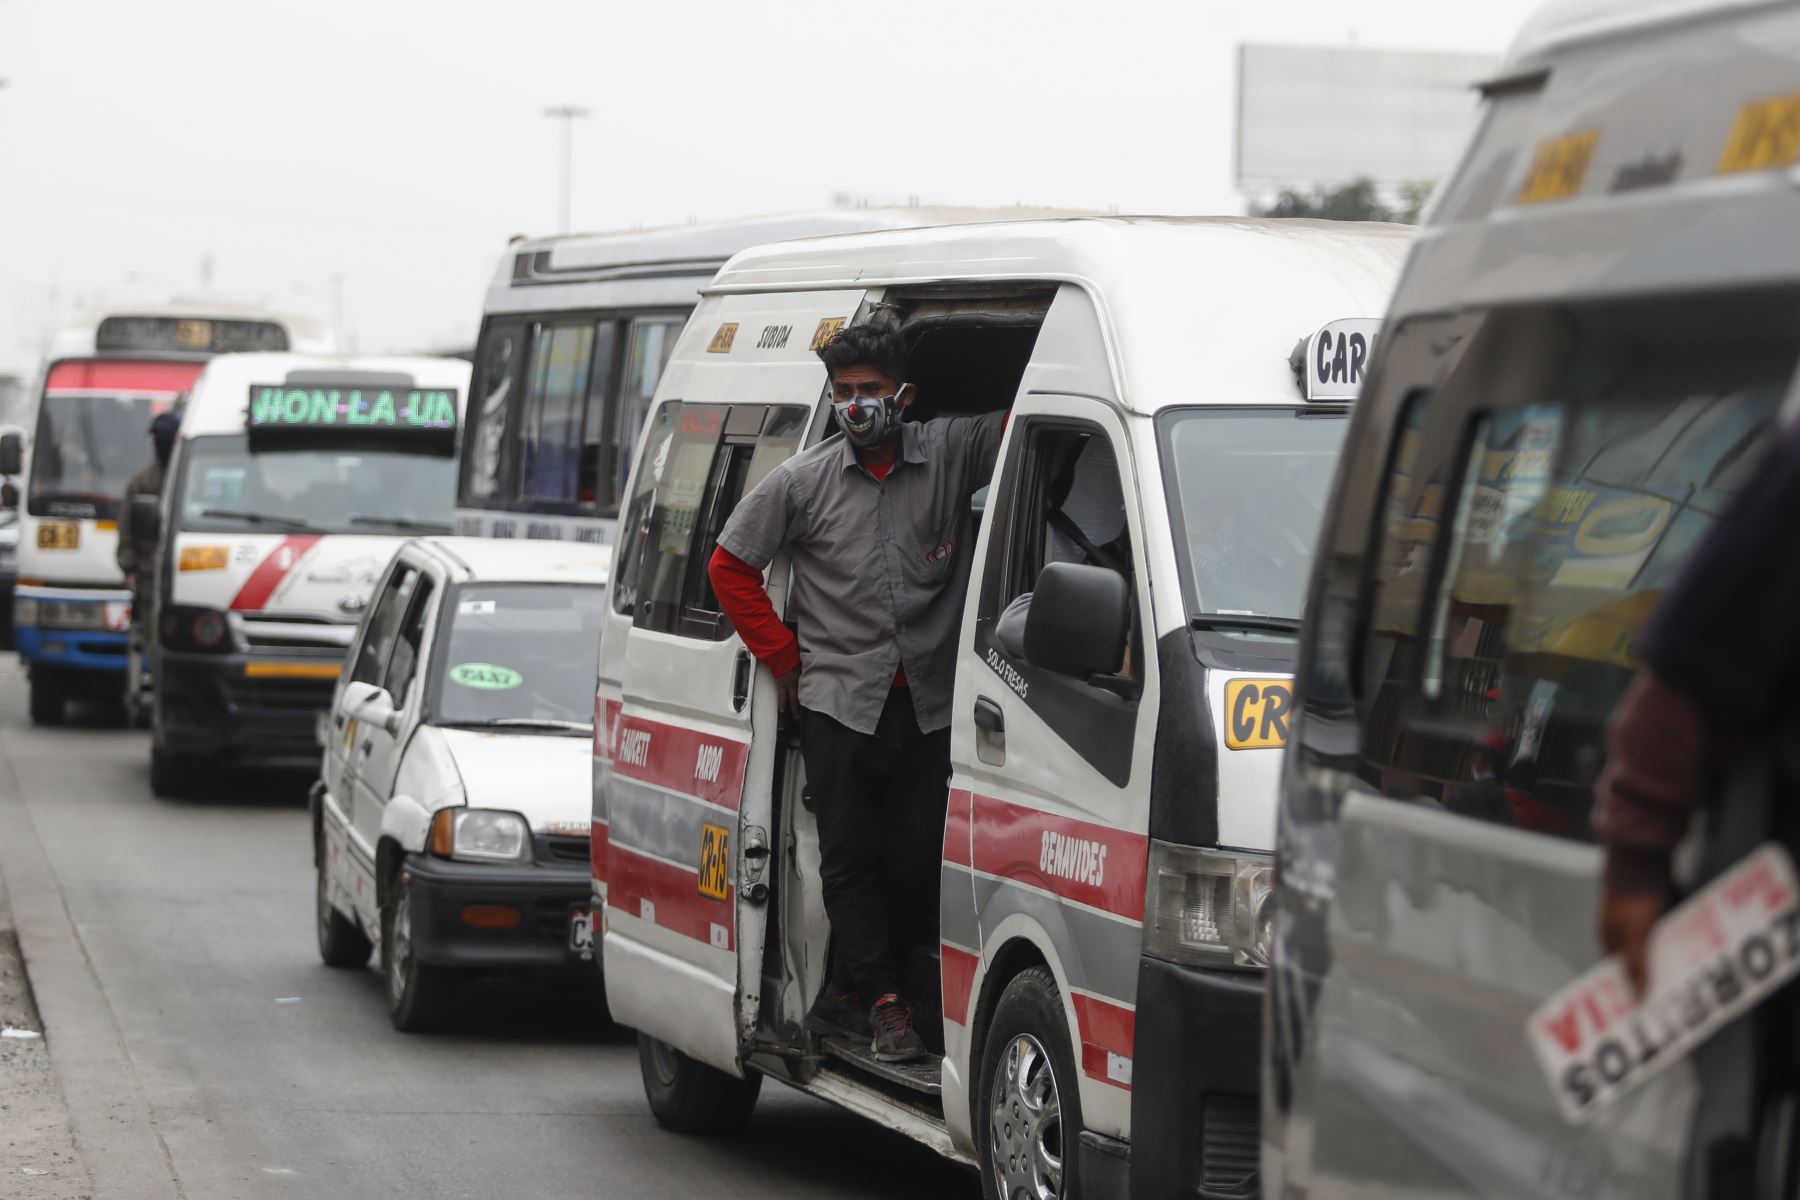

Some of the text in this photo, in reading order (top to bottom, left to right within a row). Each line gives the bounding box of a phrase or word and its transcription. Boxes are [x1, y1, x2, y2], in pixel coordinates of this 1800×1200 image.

[756, 325, 793, 349] SUBIDA
[1317, 329, 1378, 384] CAR
[460, 667, 510, 684] TAXI
[987, 647, 1028, 699] SOLO FRESAS
[619, 728, 651, 767] FAUCETT
[695, 744, 723, 783] PARDO
[700, 827, 728, 895] CR-15
[1040, 830, 1107, 887] BENAVIDES
